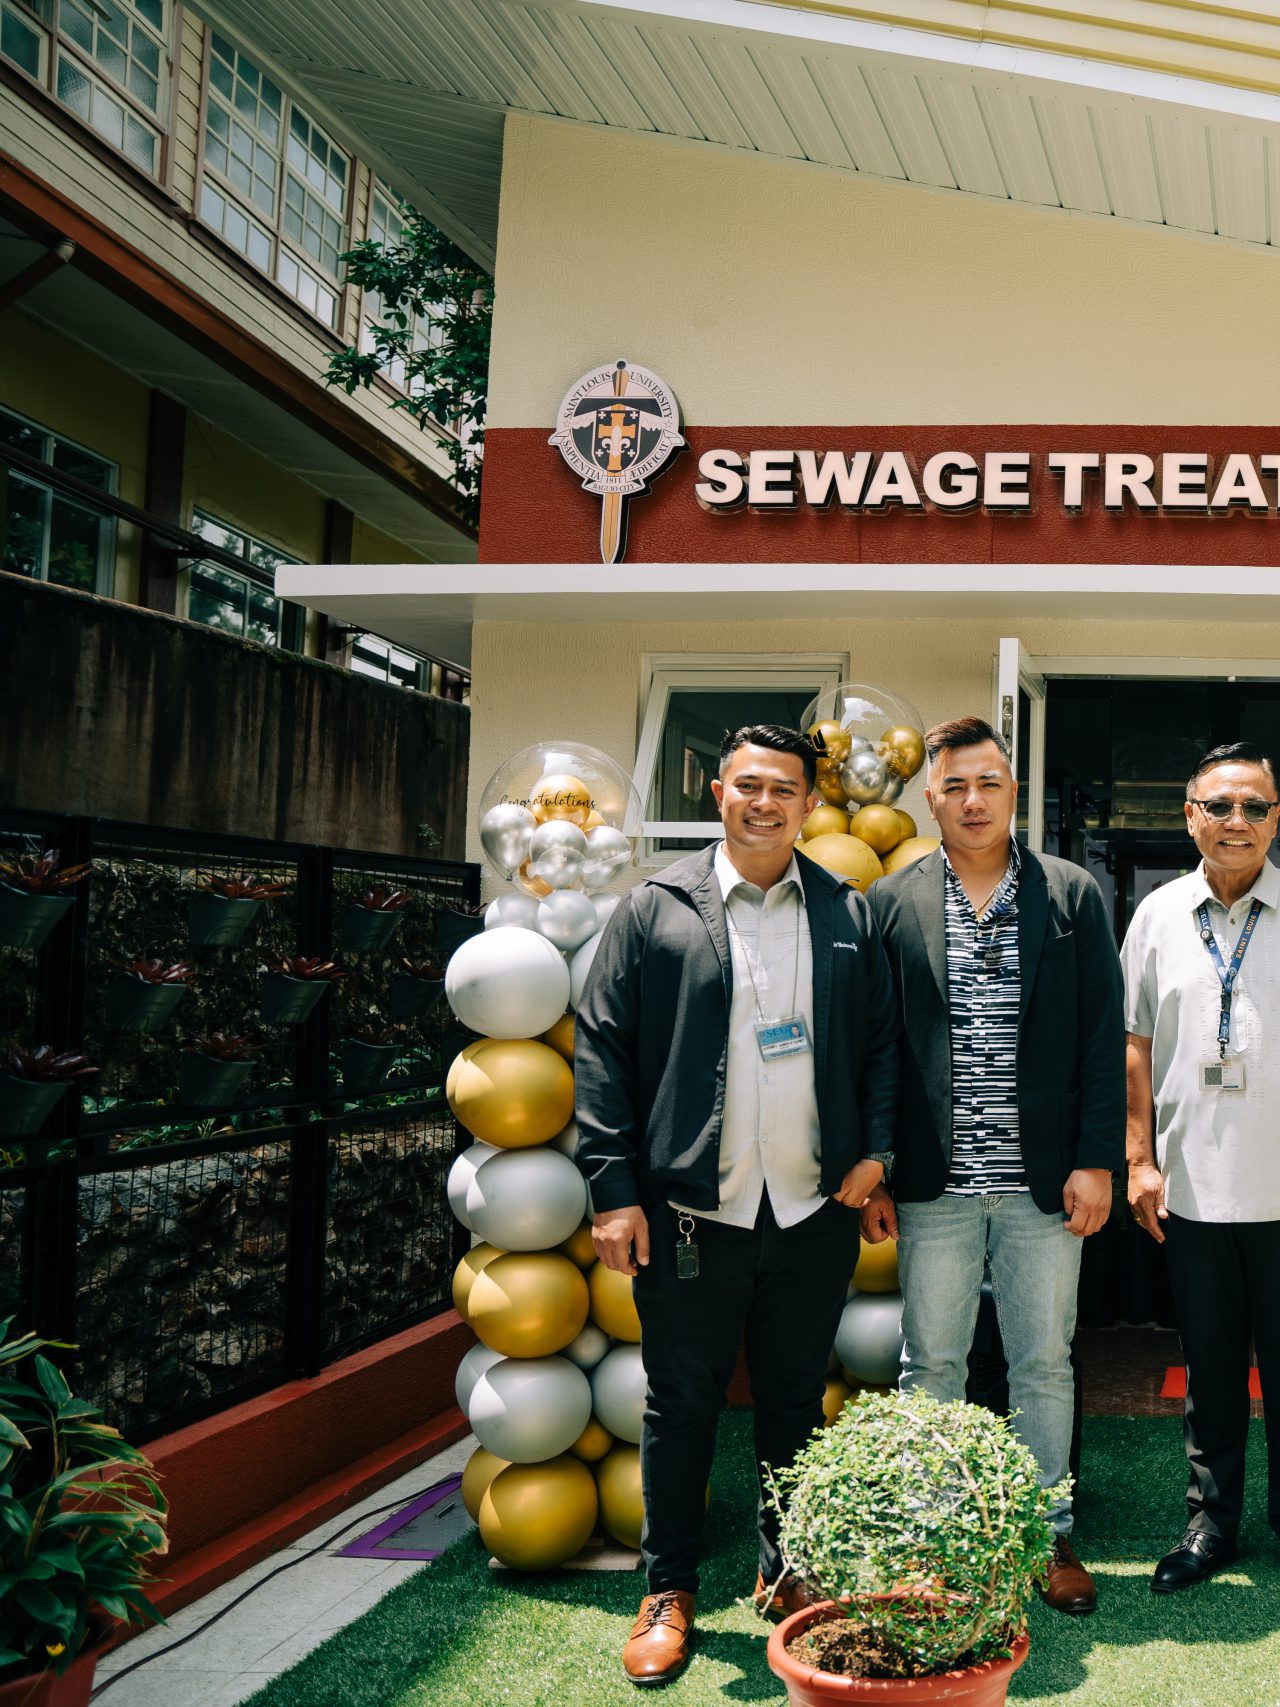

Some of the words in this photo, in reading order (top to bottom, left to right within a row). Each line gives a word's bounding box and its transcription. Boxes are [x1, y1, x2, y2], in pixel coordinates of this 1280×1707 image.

[563, 389, 583, 419] SAINT
[582, 371, 612, 393] LOUIS
[630, 371, 673, 419] UNIVERSITY
[563, 440, 601, 481] SAPIENTIA
[605, 476, 622, 484] 1911
[695, 448, 1031, 508] SEWAGE
[593, 483, 618, 491] BAGUIO
[619, 483, 635, 491] CITY
[500, 790, 598, 817] Congratulations
[1236, 937, 1247, 959] SAINT
[1245, 915, 1257, 935] LOUIS
